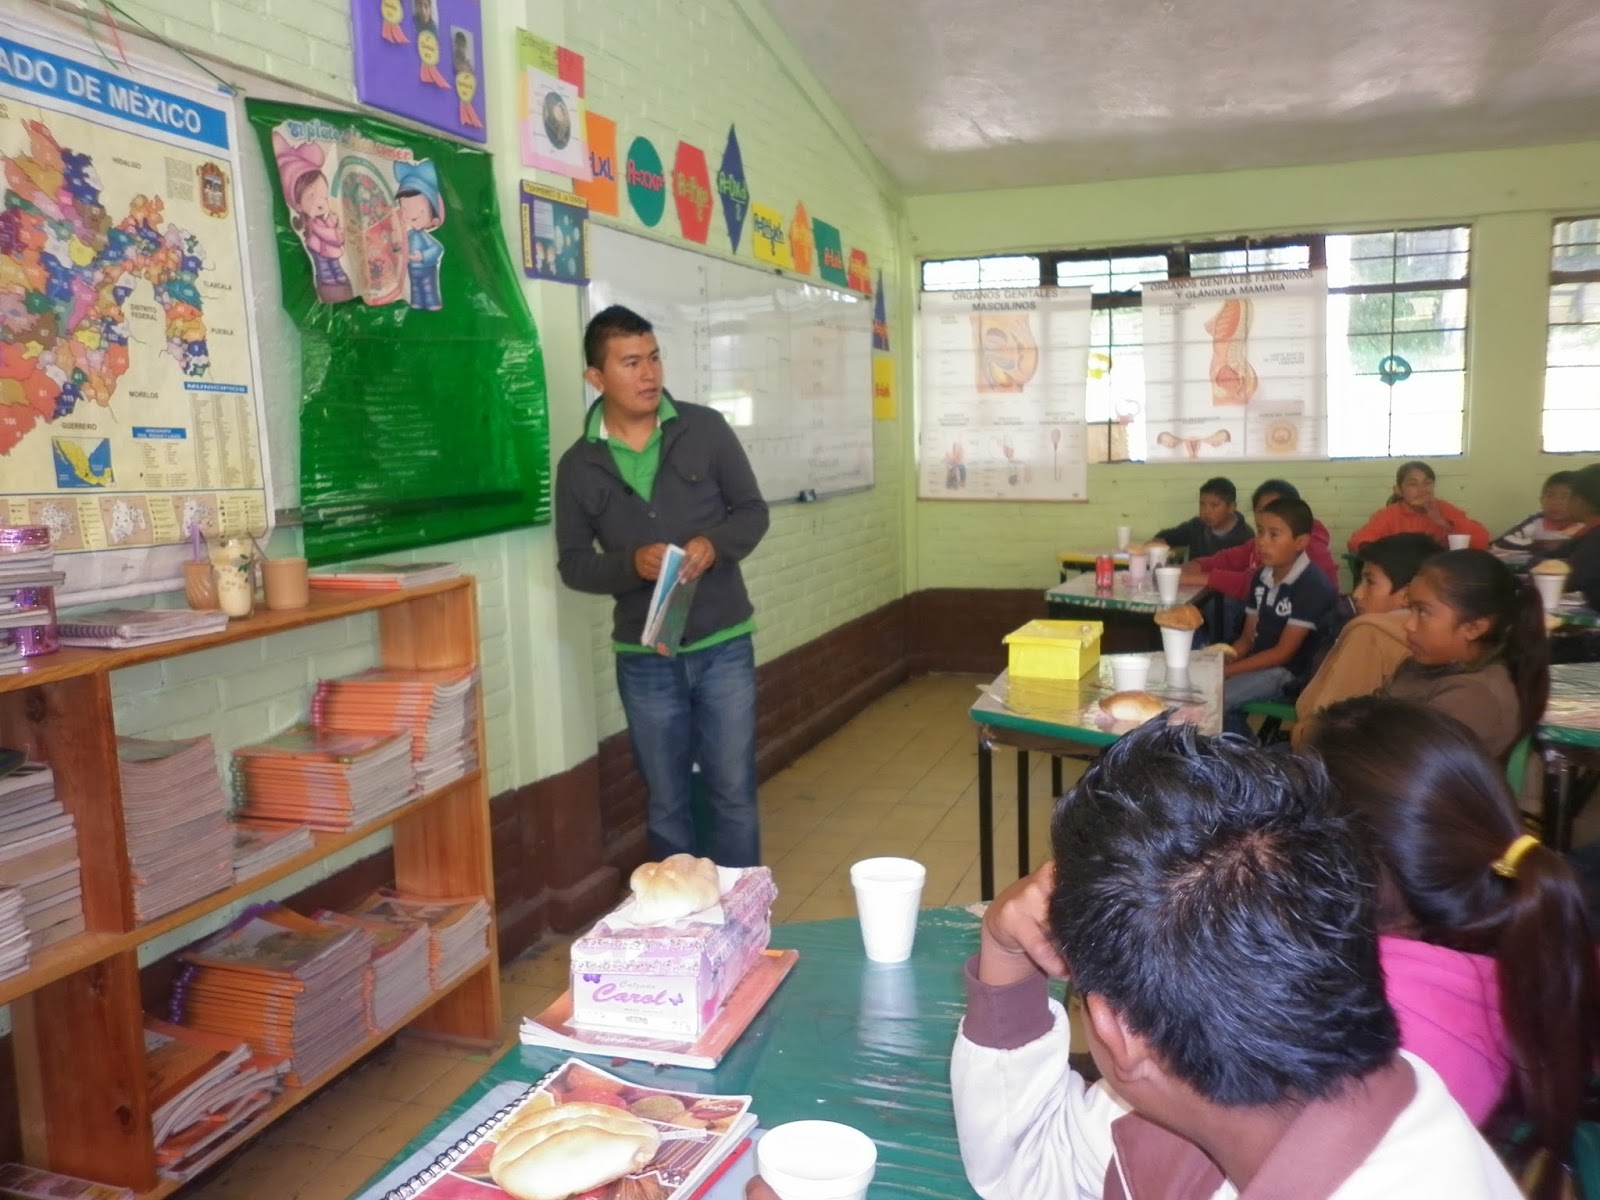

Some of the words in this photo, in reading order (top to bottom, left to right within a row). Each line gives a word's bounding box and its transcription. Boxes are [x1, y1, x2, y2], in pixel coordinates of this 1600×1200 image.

[65, 67, 102, 104] DE
[108, 84, 202, 134] MÉXICO
[112, 156, 142, 170] HIDALGO
[1200, 274, 1251, 287] GENITALES
[1255, 270, 1314, 283] FEMENINOS
[202, 281, 232, 291] TLAXCALA
[1177, 291, 1182, 299] Y
[1240, 283, 1286, 294] MAMARIA
[1004, 288, 1058, 299] GENITALES
[130, 303, 158, 313] DISTRITO
[972, 301, 1037, 312] MASCULINOS
[131, 312, 158, 321] FEDERAL
[211, 327, 234, 336] PUEBLA
[186, 382, 246, 393] MUNICIPIOS
[128, 390, 159, 400] MORELOS
[61, 421, 98, 431] GUERRERO
[591, 982, 668, 1006] Carol
